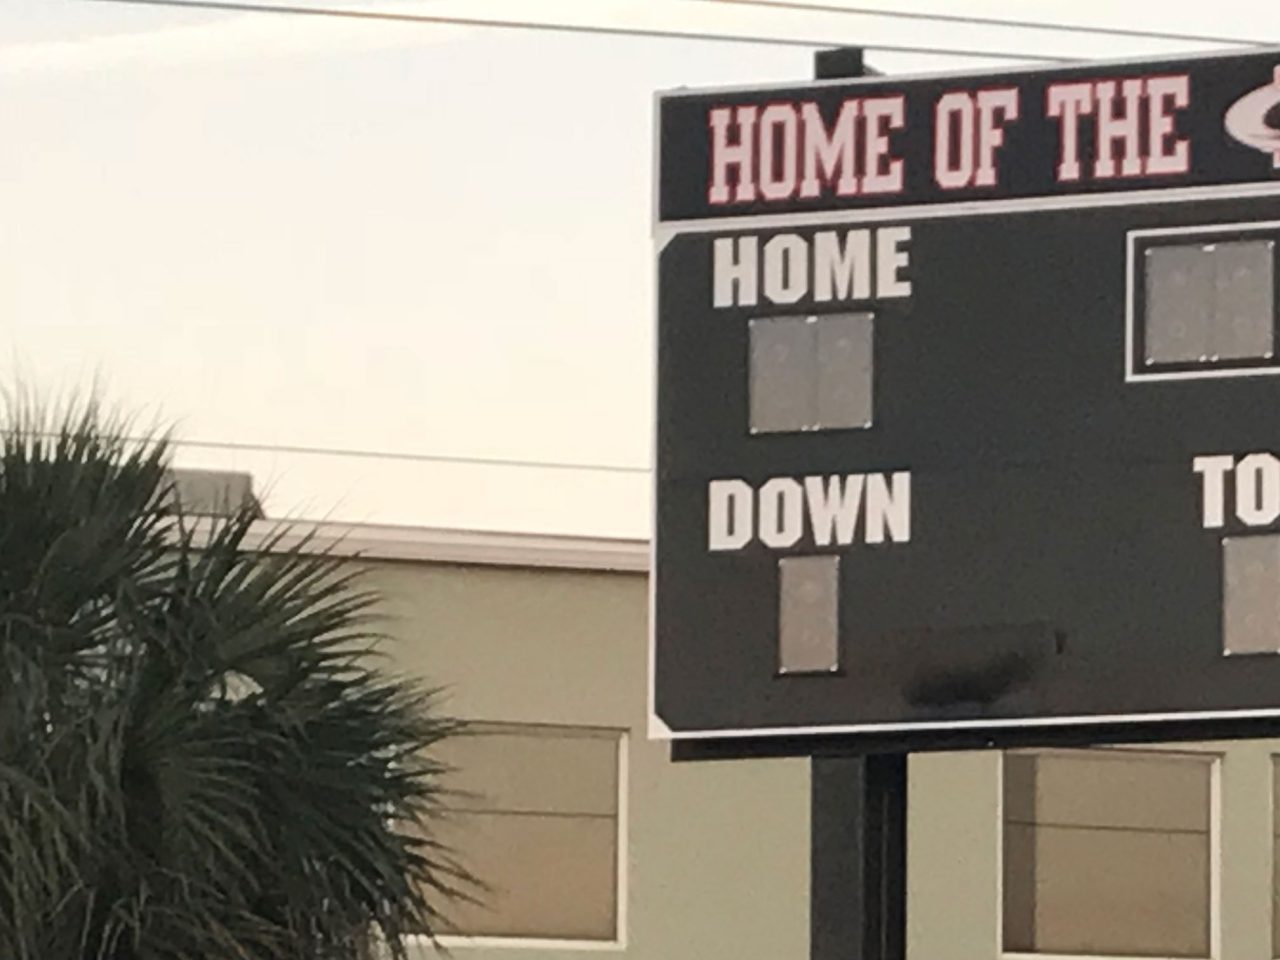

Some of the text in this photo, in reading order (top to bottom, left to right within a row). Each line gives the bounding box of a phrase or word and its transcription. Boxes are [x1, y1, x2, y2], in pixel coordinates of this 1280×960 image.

[708, 96, 905, 204] HOME
[933, 87, 1019, 190] OF
[1047, 74, 1190, 181] THE
[712, 226, 912, 308] HOME
[708, 470, 912, 552] DOWN
